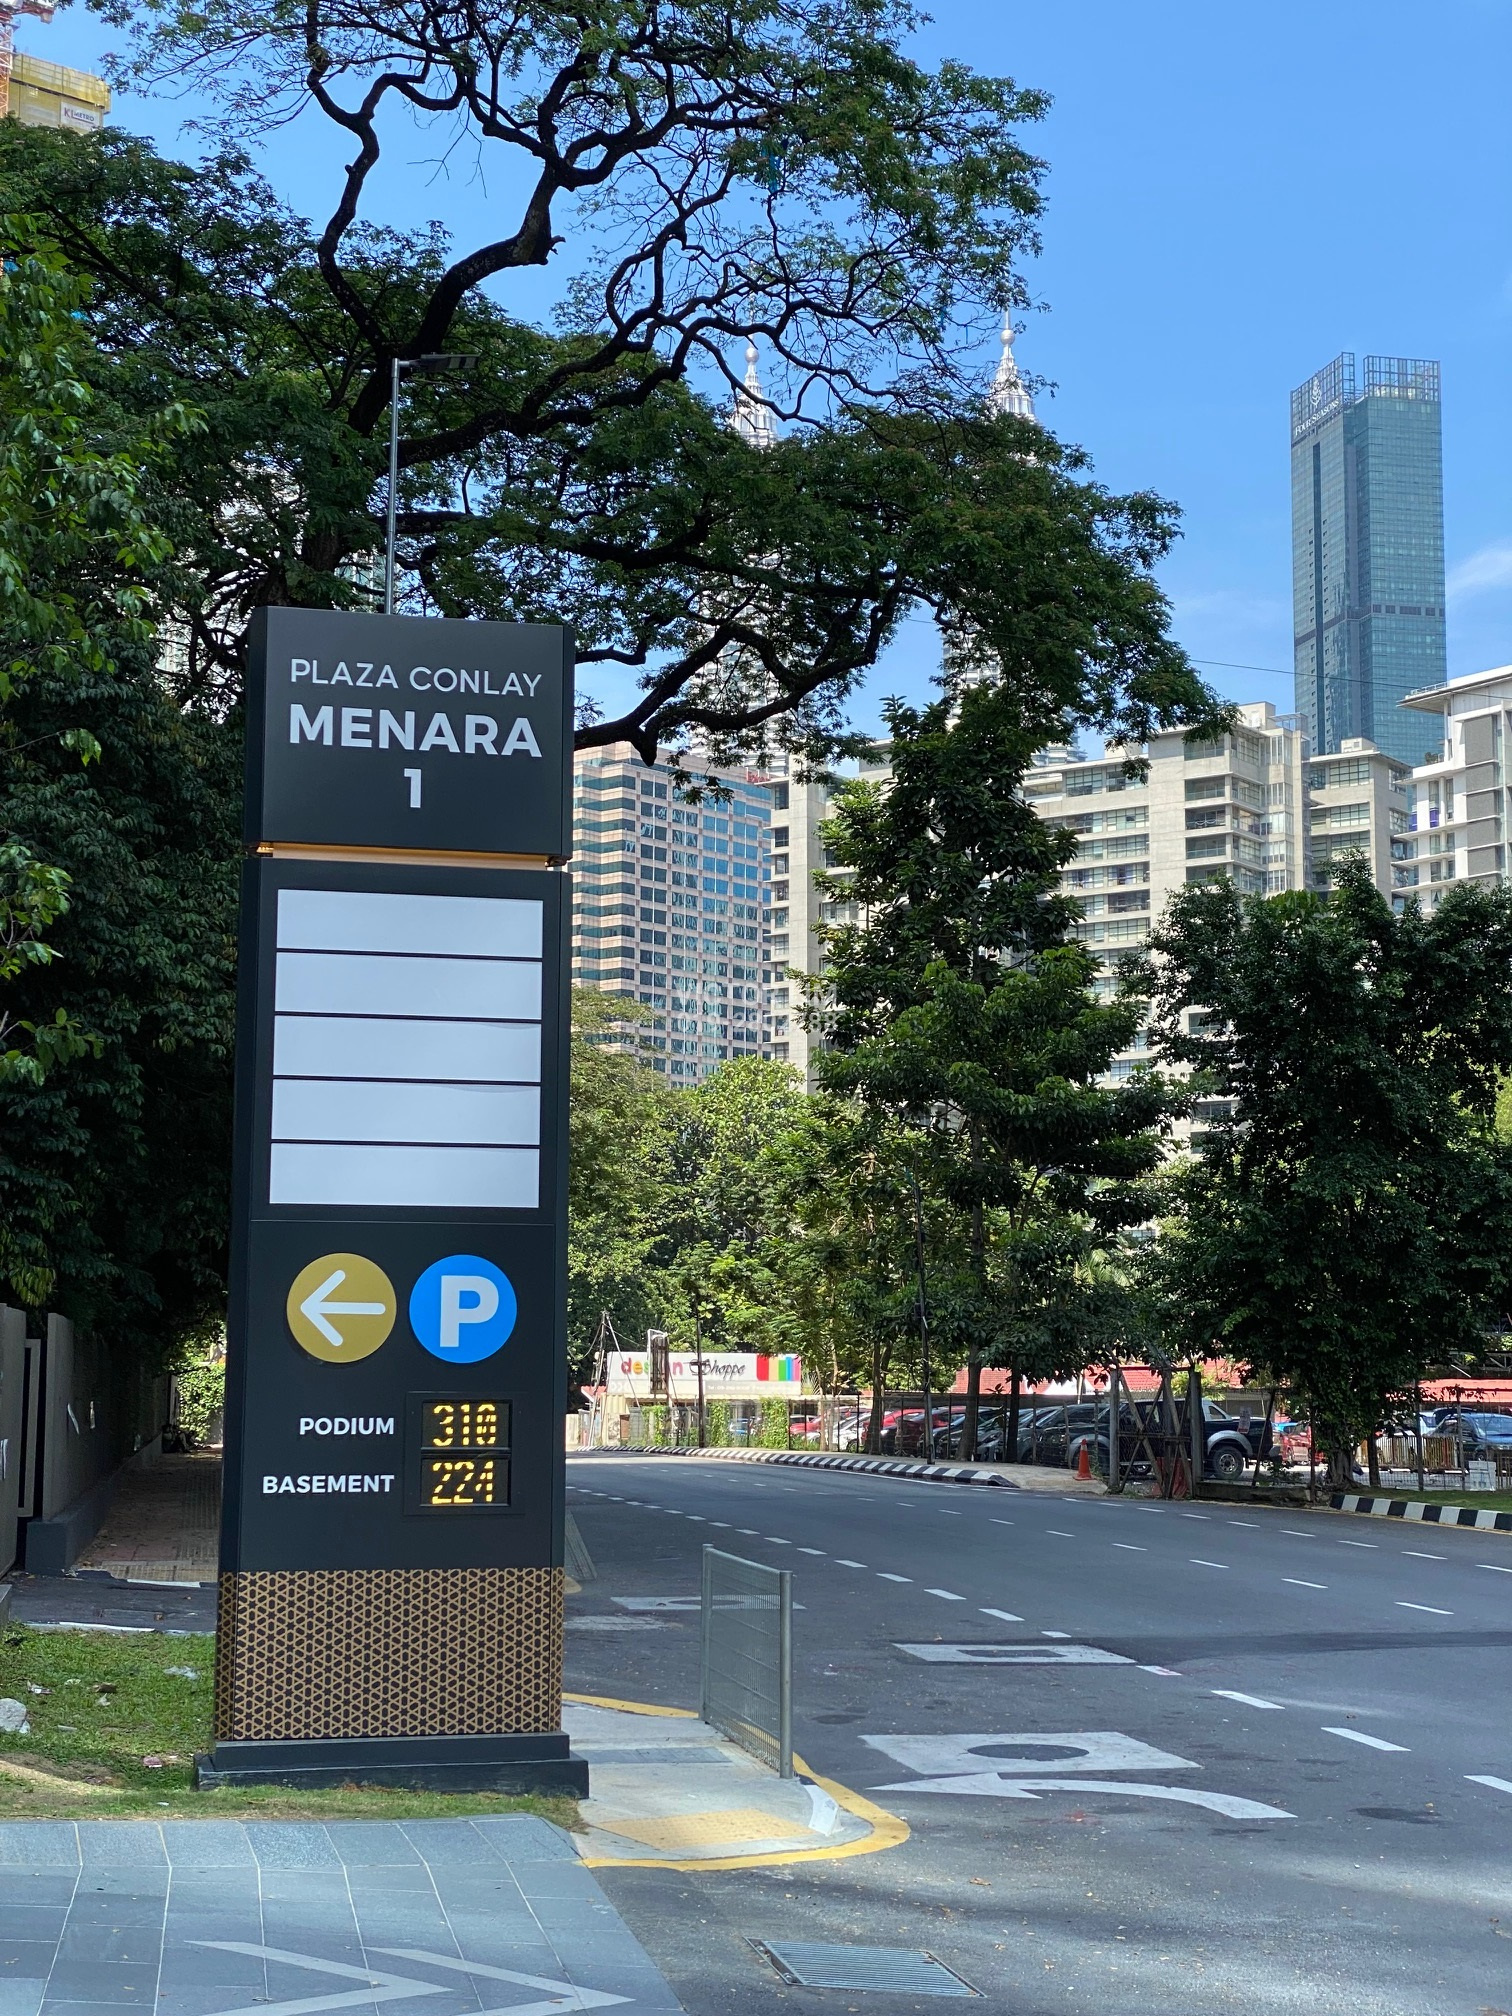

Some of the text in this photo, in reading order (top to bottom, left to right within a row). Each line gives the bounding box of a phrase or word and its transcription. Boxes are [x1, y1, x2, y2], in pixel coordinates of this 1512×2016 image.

[1295, 398, 1339, 436] FOUR SEASONS
[290, 658, 542, 697] PLAZA CONLAY
[290, 703, 543, 758] MENARA
[403, 768, 422, 809] 1
[440, 1275, 499, 1348] P
[299, 1417, 395, 1436] PODIUM
[262, 1474, 395, 1494] BASEMENT
